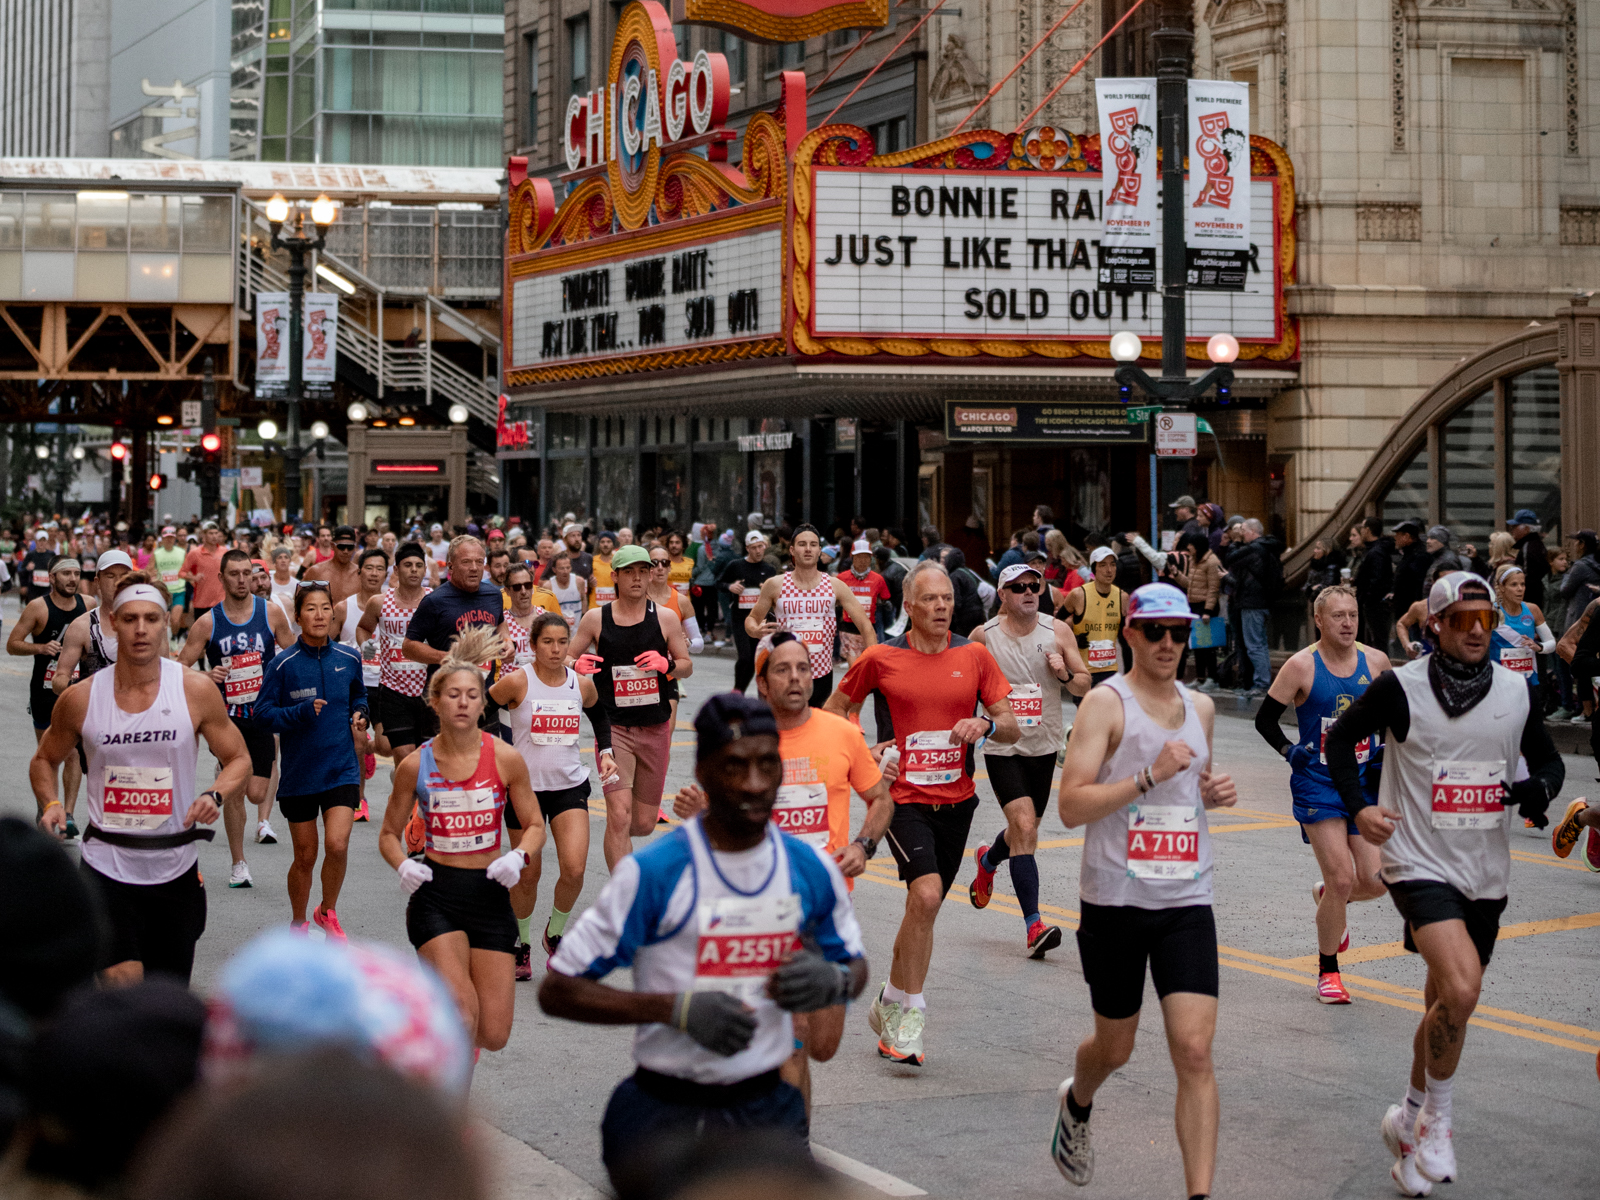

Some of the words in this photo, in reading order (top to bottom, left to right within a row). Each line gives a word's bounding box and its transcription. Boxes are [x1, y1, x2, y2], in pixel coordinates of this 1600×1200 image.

[1215, 97, 1243, 106] PREMIERE
[564, 49, 714, 172] CHICAGO
[891, 185, 1018, 218] BONNIE
[1106, 219, 1142, 227] NOVEMBER
[1194, 221, 1235, 229] NOVEMBER
[824, 234, 917, 267] JUST
[943, 237, 1012, 269] LIKE
[1105, 256, 1150, 267] LoopChicago.com
[1193, 258, 1242, 269] LoopChicago.com
[964, 287, 1050, 320] SOLD
[1069, 287, 1148, 322] OUT!
[961, 412, 1011, 422] CHICAGO
[1041, 408, 1053, 416] GO
[1053, 408, 1080, 416] BEHIND
[1080, 408, 1094, 416] THE
[1094, 408, 1120, 416] SCENES
[1136, 409, 1151, 421] Sta
[1034, 417, 1048, 425] THE
[1049, 417, 1074, 425] ICONIC
[960, 425, 993, 434] MARQUEE
[783, 600, 804, 615] FIVE
[805, 599, 831, 614] GUYS
[384, 620, 404, 635] FIVE
[456, 609, 496, 632] CHICAGO
[241, 654, 261, 664] 21224
[391, 649, 399, 659] A
[226, 683, 233, 693] B
[235, 677, 263, 692] 21224
[615, 681, 624, 692] A
[626, 678, 657, 692] 8038
[533, 717, 542, 727] A
[545, 717, 579, 728] 10105
[907, 752, 918, 765] A
[921, 750, 962, 765] 25459
[105, 790, 117, 804] A
[119, 791, 171, 807] 20034
[1433, 788, 1448, 803] A
[1451, 787, 1504, 804] 20165
[431, 815, 442, 829] A
[444, 812, 494, 830] 20109
[778, 807, 826, 828] 2087
[1130, 833, 1146, 852] A
[1151, 833, 1195, 853] 7101
[700, 938, 720, 964] A
